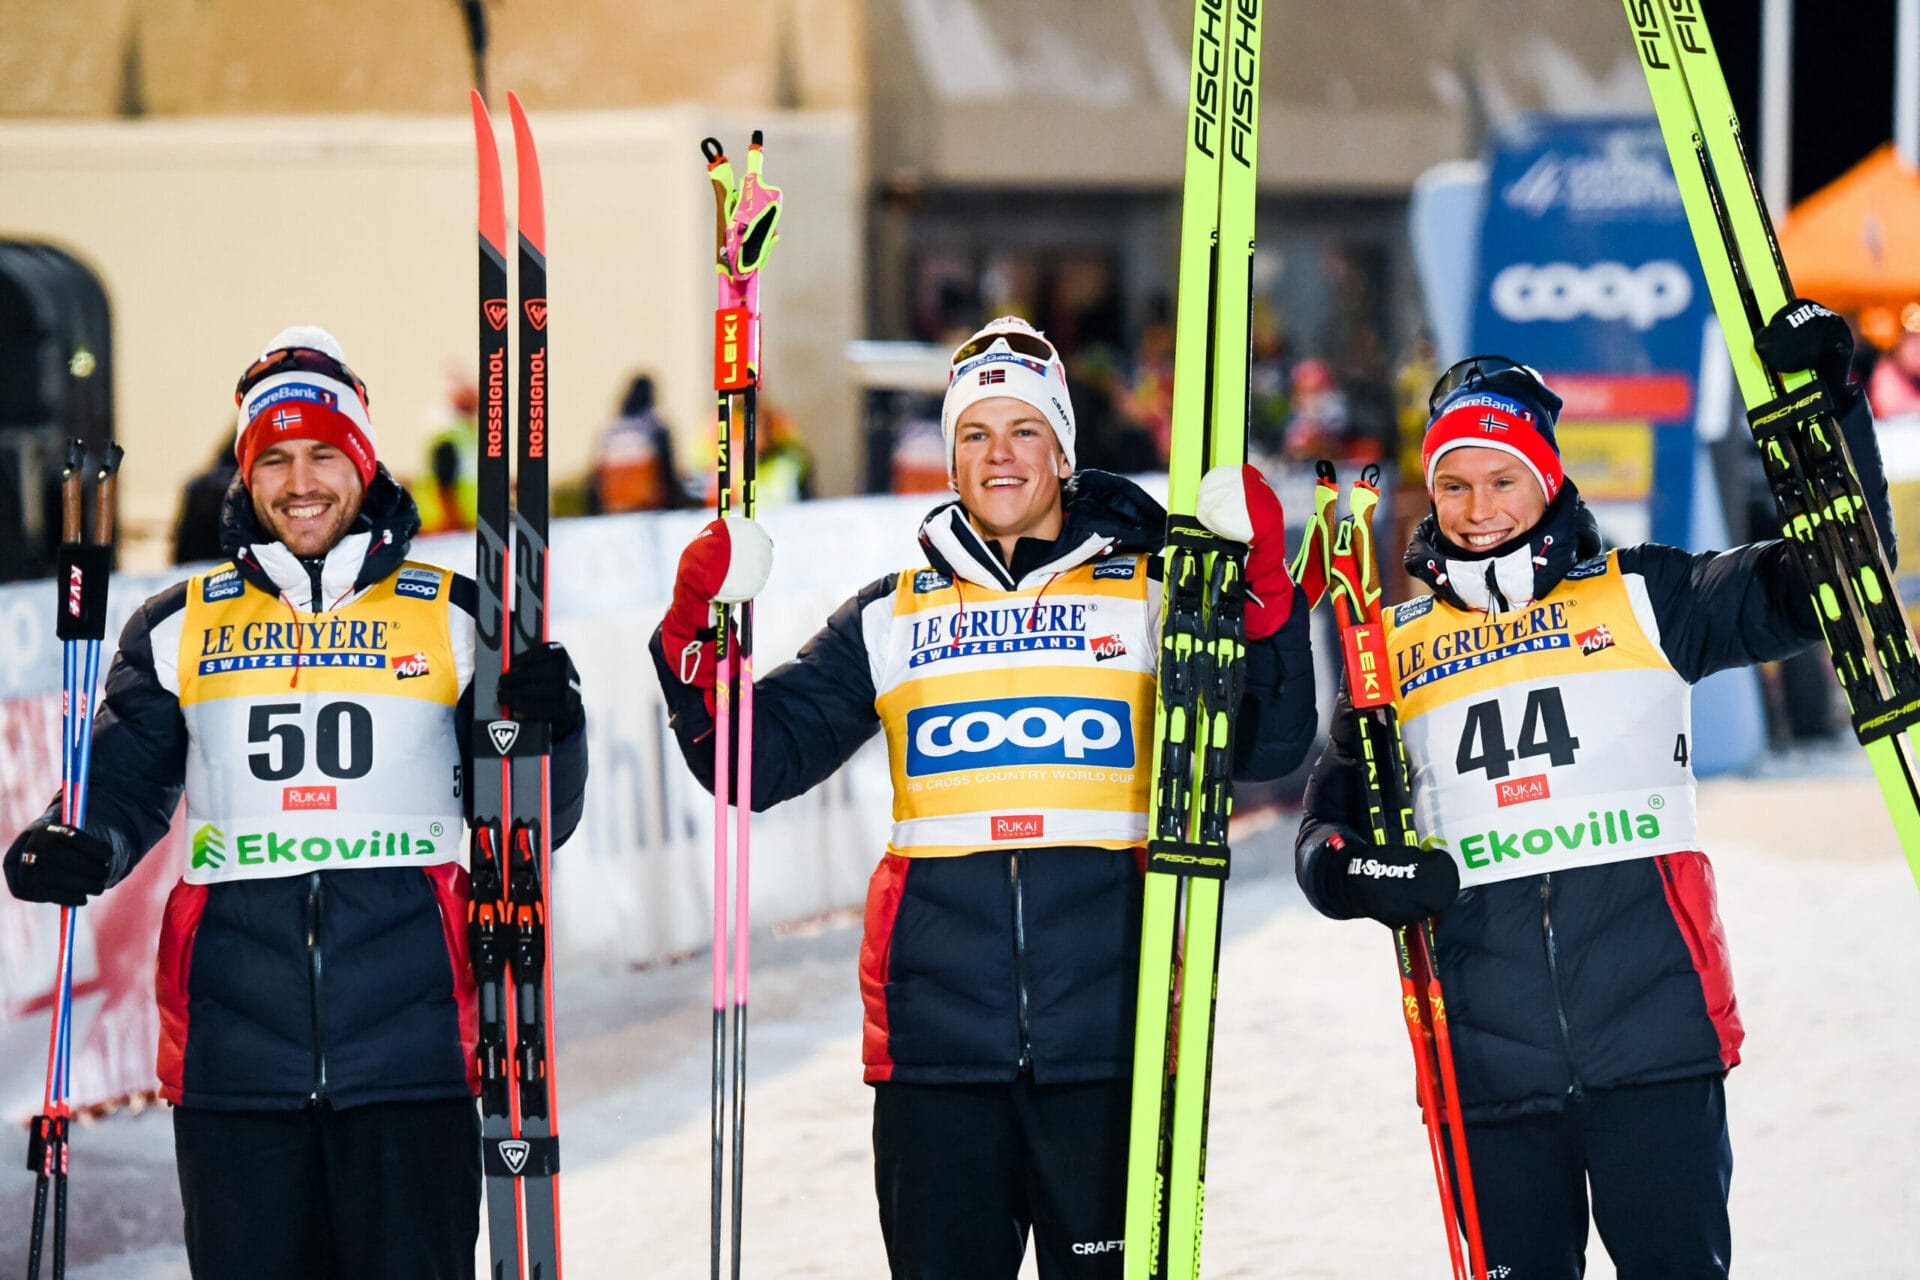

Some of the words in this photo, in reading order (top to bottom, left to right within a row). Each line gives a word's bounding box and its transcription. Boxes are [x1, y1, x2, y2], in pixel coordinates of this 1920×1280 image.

[1491, 261, 1694, 331] coop
[724, 314, 738, 384] LEKI
[249, 386, 318, 421] SpareBank
[488, 347, 504, 458] ROSSIGNOL
[529, 347, 545, 458] ROSSIGNOL
[1752, 391, 1823, 430] FISCHER
[397, 582, 438, 596] coop
[1094, 567, 1133, 576] coop
[208, 586, 239, 598] coop
[1400, 607, 1428, 622] coop
[201, 625, 235, 657] LE
[243, 615, 388, 651] GRUYÈRE
[912, 616, 942, 651] LE
[916, 637, 1077, 665] SWITZERLAND
[1096, 641, 1125, 661] AOP
[1581, 632, 1613, 652] AOP
[205, 653, 378, 674] SWITZERLAND
[396, 660, 428, 677] AOP
[1355, 631, 1381, 700] LEKI
[1396, 641, 1426, 683] LE
[248, 701, 374, 781] 50
[916, 707, 1122, 759] coop
[1456, 686, 1580, 781] 44
[1359, 717, 1380, 790] LEKI
[289, 790, 331, 803] RUKAI
[907, 783, 923, 794] FIS
[926, 775, 969, 790] CROSS
[975, 769, 1048, 783] COUNTRY
[1053, 769, 1106, 783] WORLD
[1110, 773, 1135, 784] CUP
[1501, 781, 1543, 799] RUKAI
[997, 819, 1037, 833] RUKAI
[1460, 809, 1660, 869] Ekovilla
[237, 830, 436, 866] Ekovilla
[1152, 852, 1227, 867] FISCHER
[1072, 1239, 1125, 1255] CRAFT
